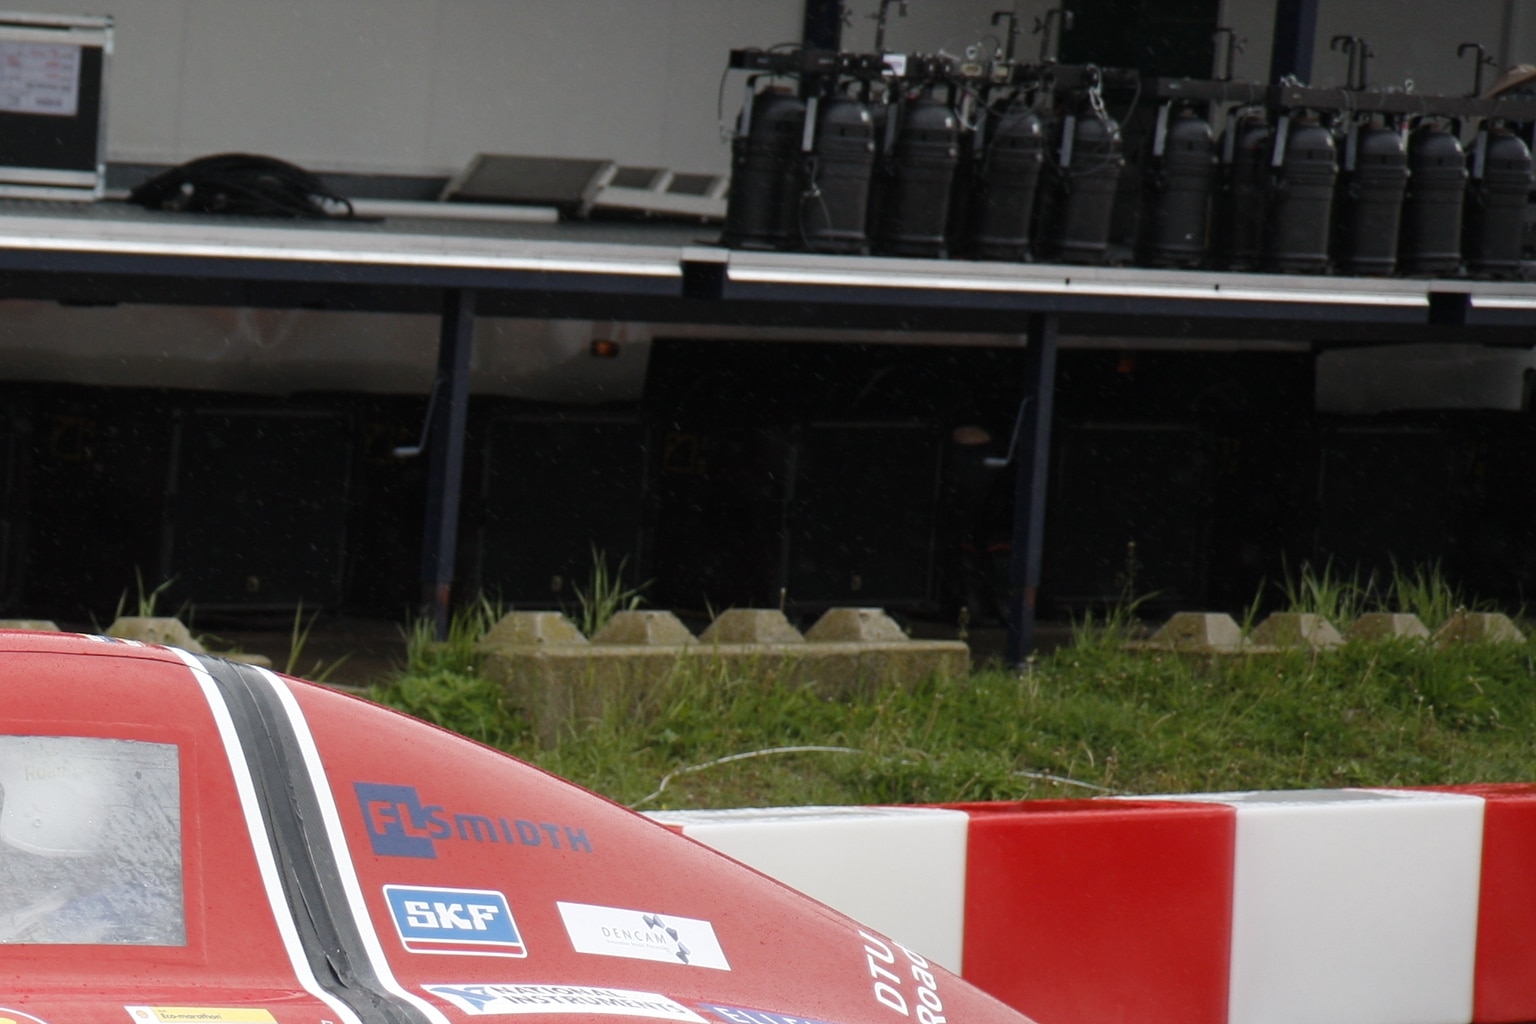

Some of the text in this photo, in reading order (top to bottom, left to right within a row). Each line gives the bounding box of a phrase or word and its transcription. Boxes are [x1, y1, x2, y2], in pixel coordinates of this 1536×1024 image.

[403, 900, 500, 931] SKF
[600, 926, 667, 945] DENCAM
[858, 929, 910, 1017] DTU
[488, 986, 629, 999] NATIONAL
[501, 995, 687, 1014] INSTRUMENTS
